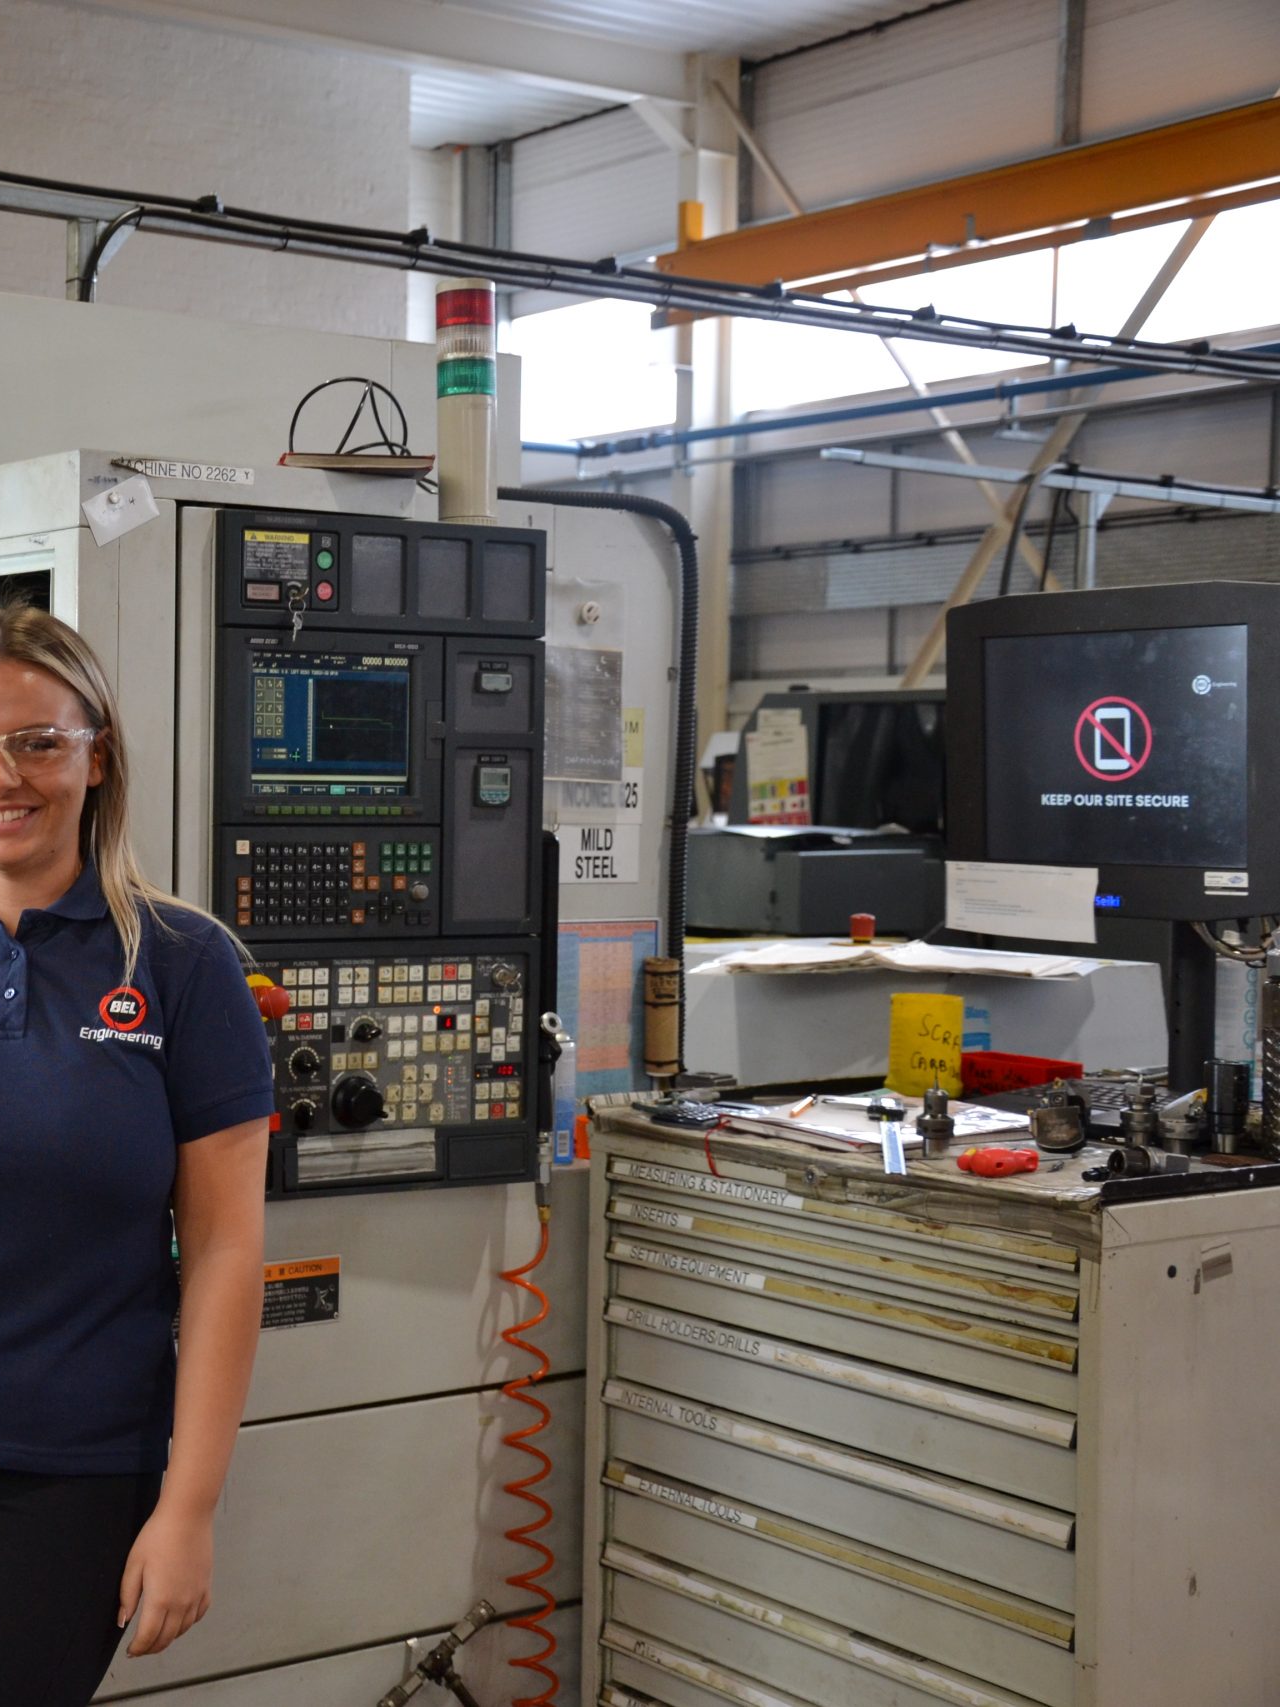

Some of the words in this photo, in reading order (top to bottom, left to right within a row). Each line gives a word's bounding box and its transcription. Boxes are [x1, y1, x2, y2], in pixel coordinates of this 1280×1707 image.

[181, 464, 202, 479] NO
[206, 466, 237, 482] 2262
[1041, 793, 1072, 806] KEEP
[1074, 794, 1103, 807] OUR
[1105, 794, 1133, 807] SITE
[1135, 795, 1190, 808] SECURE
[581, 828, 613, 851] MILD
[575, 855, 618, 879] STEEL
[110, 1000, 137, 1015] BEL
[79, 1026, 163, 1050] Engineering
[630, 1163, 695, 1189] MEASURING
[699, 1181, 707, 1192] &
[710, 1181, 789, 1206] STATIONARY
[631, 1204, 679, 1228] INSERTS
[288, 1263, 322, 1275] CAUTION
[629, 1245, 678, 1269] SETTING
[680, 1258, 750, 1284] EQUIPMENT
[626, 1308, 657, 1329] DRILL
[679, 1406, 718, 1431] TOOLS
[702, 1499, 743, 1523] TOOLS
